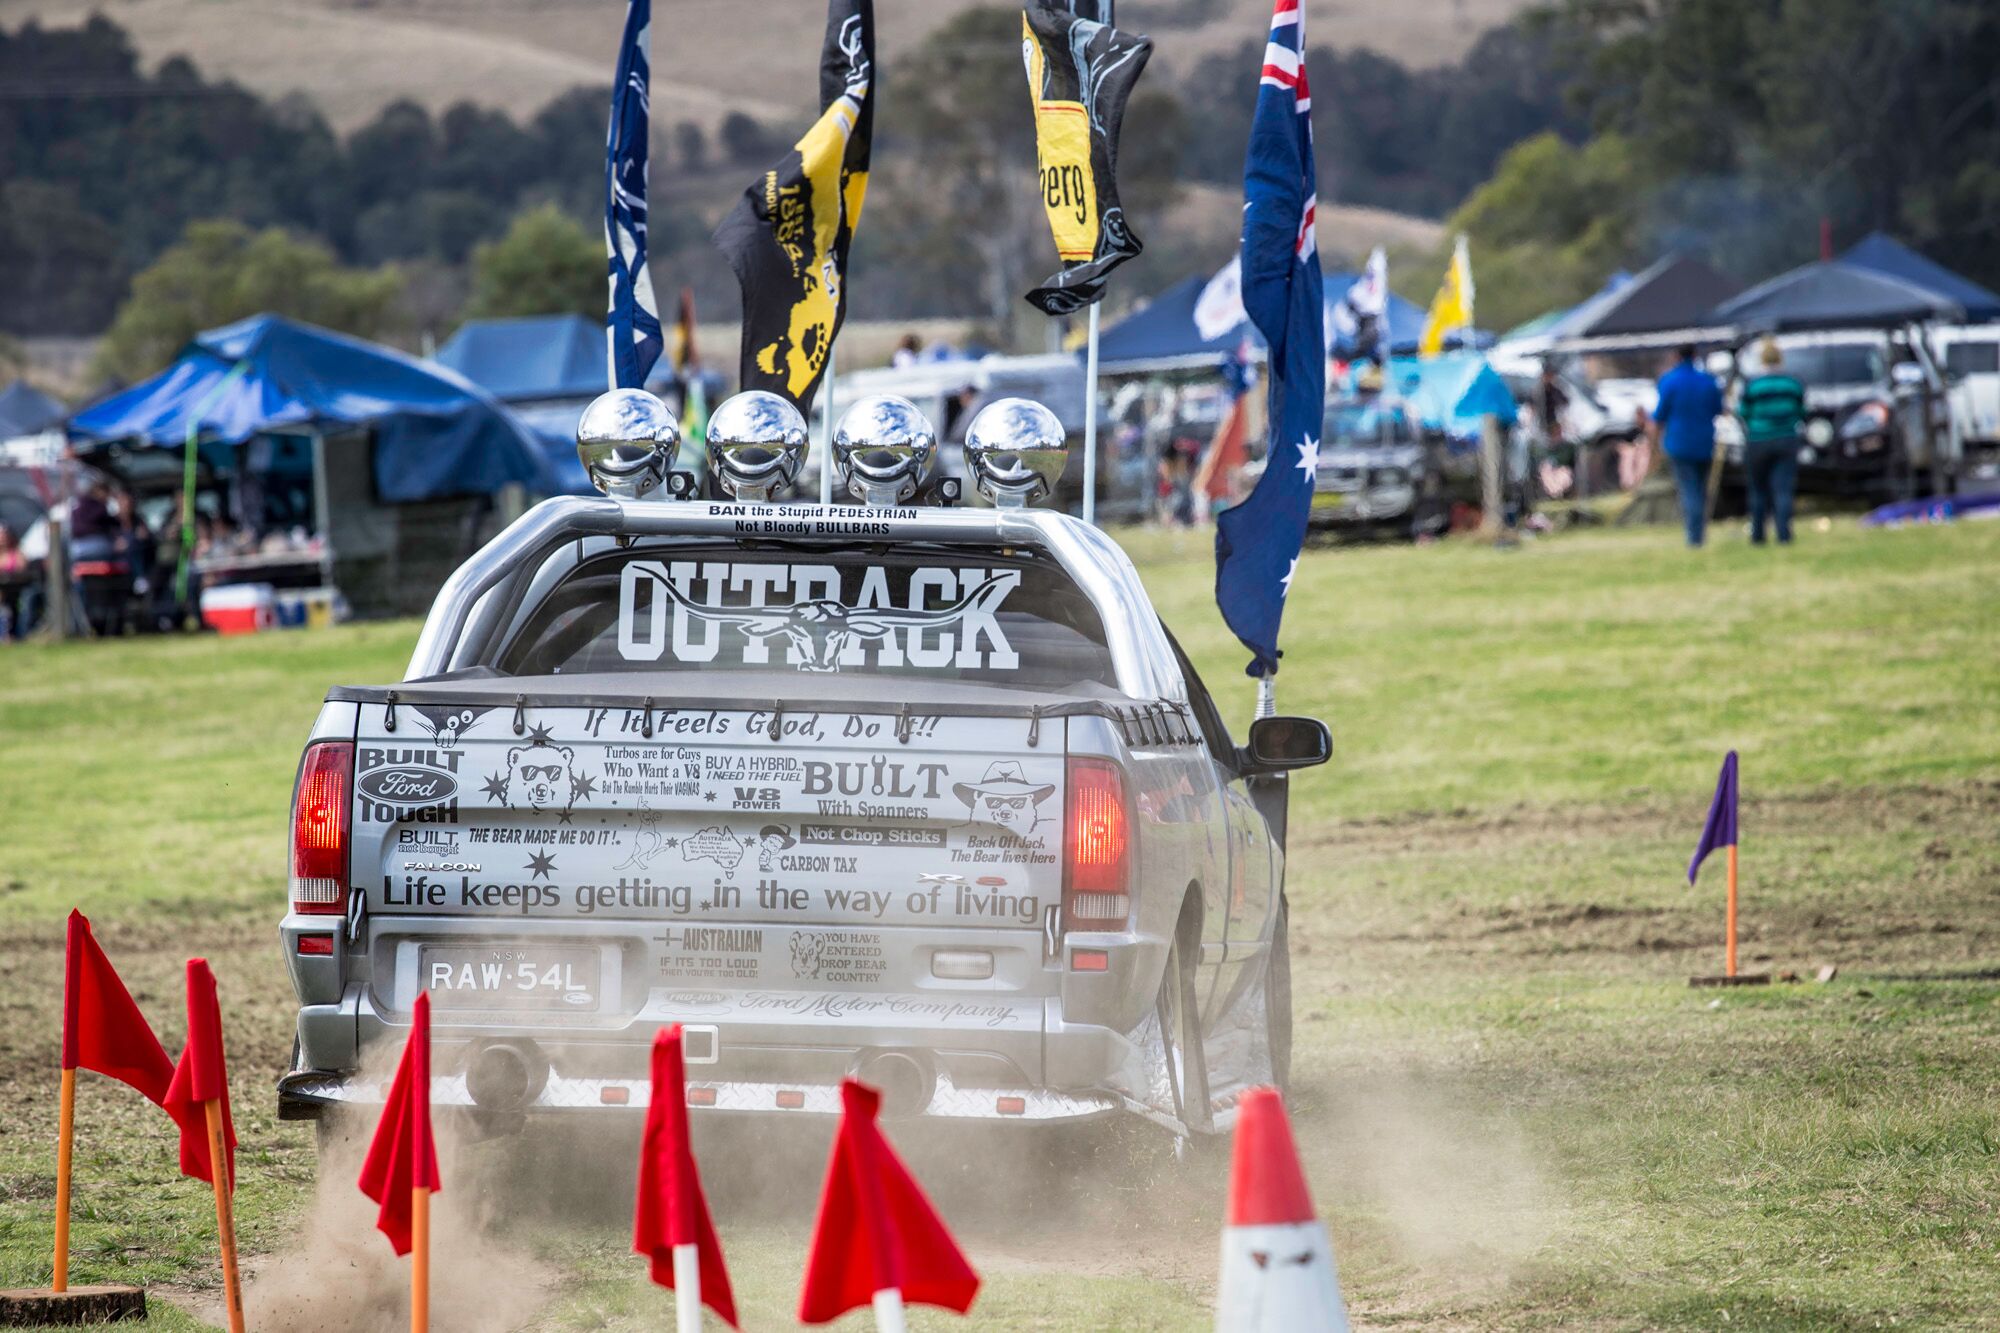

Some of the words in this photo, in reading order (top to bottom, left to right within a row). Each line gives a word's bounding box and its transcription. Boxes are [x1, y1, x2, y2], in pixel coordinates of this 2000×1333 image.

[709, 505, 746, 516] BAN
[751, 506, 774, 517] the
[778, 506, 823, 519] Stupid
[828, 508, 918, 519] PEDESTRIAN
[735, 520, 759, 532] Not
[764, 520, 811, 535] Bloody
[816, 522, 890, 535] BULLBARS
[584, 707, 609, 738] If
[620, 710, 644, 733] It
[657, 710, 731, 734] Feels
[842, 715, 881, 738] Do
[358, 748, 465, 775] BUILT
[604, 745, 640, 759] Turbos
[642, 748, 658, 760] are
[661, 746, 674, 760] for
[677, 747, 701, 763] Guys
[705, 756, 732, 770] BUY
[736, 757, 746, 770] A
[603, 762, 633, 778] Who
[637, 763, 669, 778] Want
[672, 768, 680, 779] a
[684, 763, 701, 780] V8
[712, 771, 746, 781] NEED
[748, 772, 774, 781] THE
[773, 772, 802, 782] FUEL
[801, 755, 950, 799] BUILT
[378, 771, 438, 796] Ford
[602, 782, 612, 794] But
[613, 781, 623, 794] The
[623, 781, 643, 795] Rumble
[644, 781, 659, 795] Hurts
[660, 781, 673, 795] Their
[674, 782, 700, 796] VAGINAS
[733, 787, 781, 801] V8
[357, 793, 459, 824] TOUGH
[732, 801, 781, 810] POWER
[817, 799, 852, 817] With
[858, 801, 929, 822] Spanners
[469, 827, 490, 843] THE
[492, 828, 522, 844] BEAR
[523, 829, 557, 844] MADE
[558, 830, 577, 845] ME
[579, 830, 595, 845] DO
[806, 826, 836, 840] Not
[840, 828, 883, 845] Chop
[889, 830, 941, 844] Sticks
[967, 835, 997, 849] Back
[998, 835, 1019, 849] Off
[1019, 836, 1046, 849] Jack
[398, 844, 419, 853] not
[420, 843, 460, 857] bought
[951, 849, 972, 862] The
[972, 849, 1001, 863] Bear
[1001, 850, 1028, 863] lives
[1029, 850, 1056, 864] here
[404, 861, 482, 873] FALCON
[780, 855, 830, 873] CARBON
[833, 857, 858, 873] TAX
[383, 875, 446, 906] Life
[461, 876, 561, 914] keeps
[575, 878, 692, 914] getting
[713, 878, 741, 908] in
[756, 879, 810, 910] the
[824, 890, 892, 919] way
[906, 884, 942, 914] of
[955, 885, 1039, 923] living
[682, 928, 762, 953] AUSTRALIAN
[825, 933, 847, 943] YOU
[850, 934, 881, 944] HAVE
[826, 946, 882, 957] ENTERED
[660, 957, 671, 967] IF
[675, 957, 694, 967] ITS
[700, 958, 722, 968] TOO
[726, 958, 758, 969] LOUD
[820, 959, 851, 969] DROP
[854, 960, 887, 970] BEAR
[826, 972, 881, 982] COUNTRY
[739, 991, 802, 1014] Ford
[793, 993, 883, 1018] Motor
[884, 994, 1018, 1026] Company
